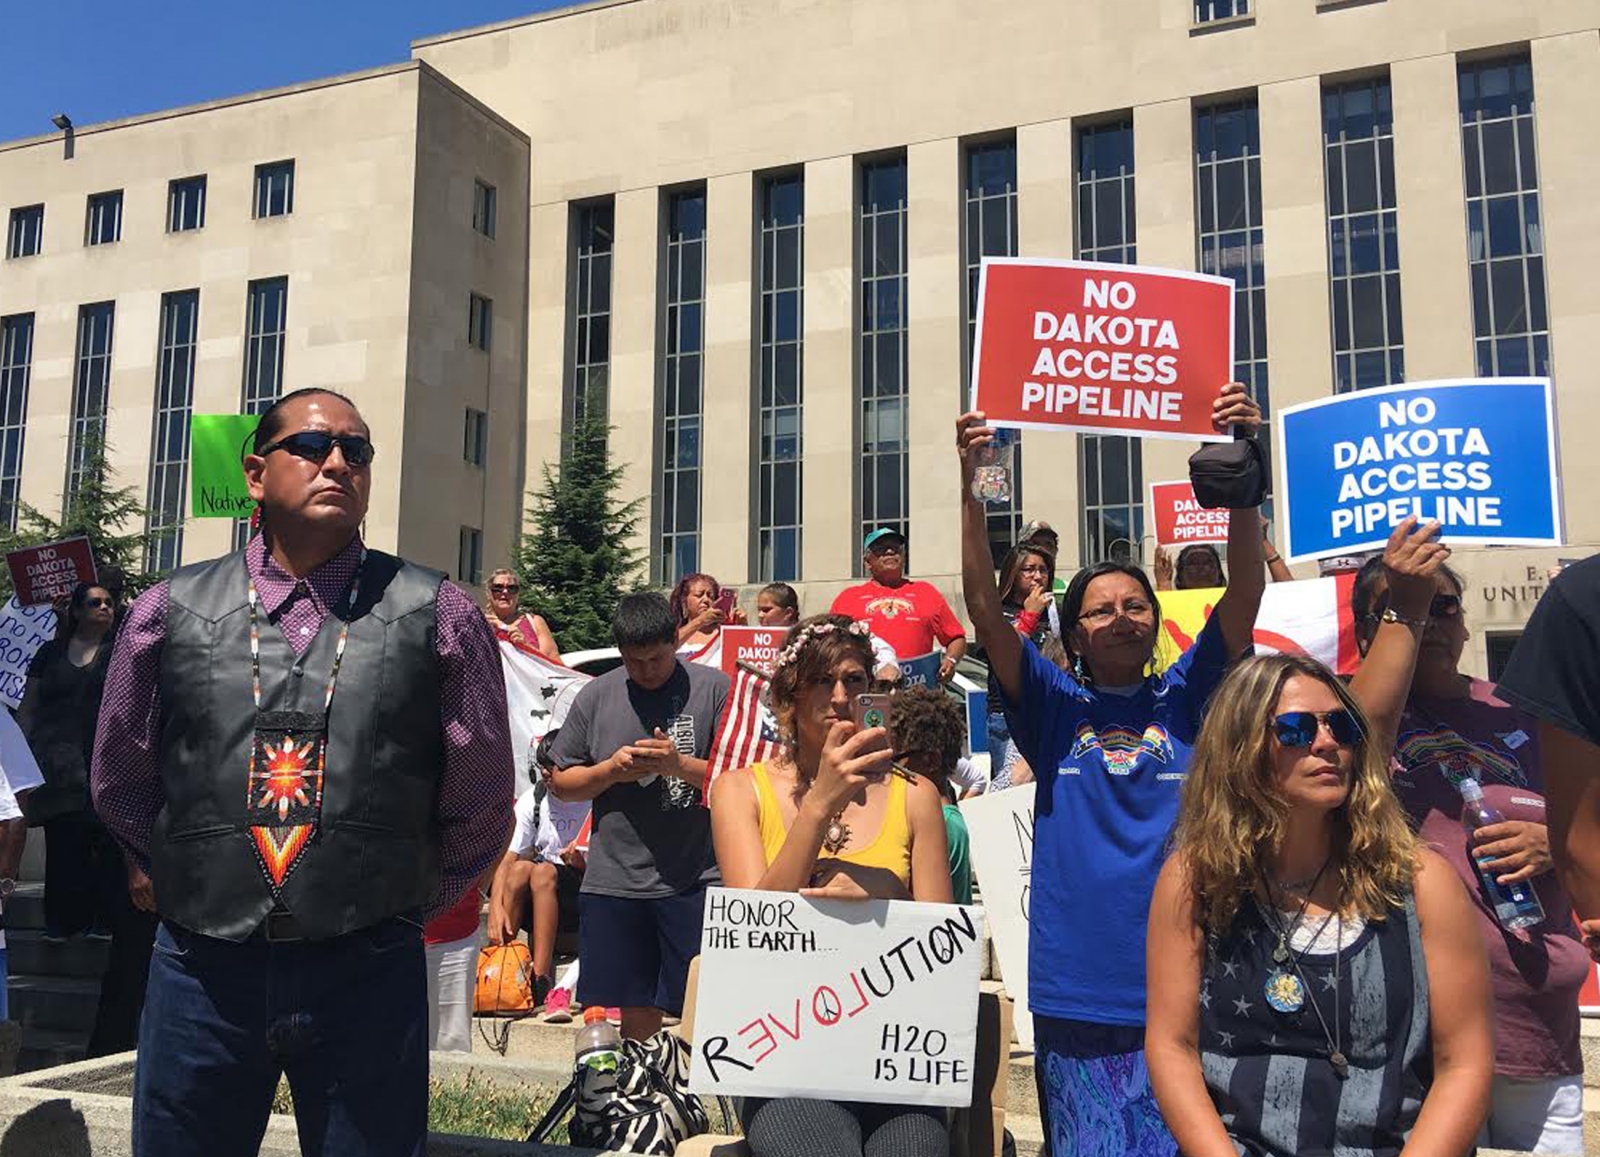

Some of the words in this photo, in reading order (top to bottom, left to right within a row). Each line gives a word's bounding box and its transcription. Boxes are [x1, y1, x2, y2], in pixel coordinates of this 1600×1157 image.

[1083, 279, 1136, 310] NO
[1033, 311, 1180, 350] DAKOTA
[1032, 347, 1178, 385] ACCESS
[1021, 382, 1183, 421] PIPELINE
[1379, 397, 1436, 428] NO
[1333, 428, 1491, 470] DAKOTA
[1338, 461, 1492, 503] ACCESS
[201, 485, 254, 514] Native
[1331, 496, 1502, 538] PIPELINE
[1173, 525, 1228, 540] PIPELIN
[26, 557, 75, 577] DAKOTA
[37, 548, 57, 562] NO
[31, 569, 78, 589] ACCESS
[32, 582, 77, 601] PIPELIN
[1483, 586, 1543, 601] UNIT
[738, 646, 779, 660] DAKOT
[754, 633, 772, 646] NO
[709, 895, 799, 931] HONOR
[704, 926, 740, 949] THE
[874, 1058, 898, 1081] IS
[908, 1057, 968, 1085] LIFE
